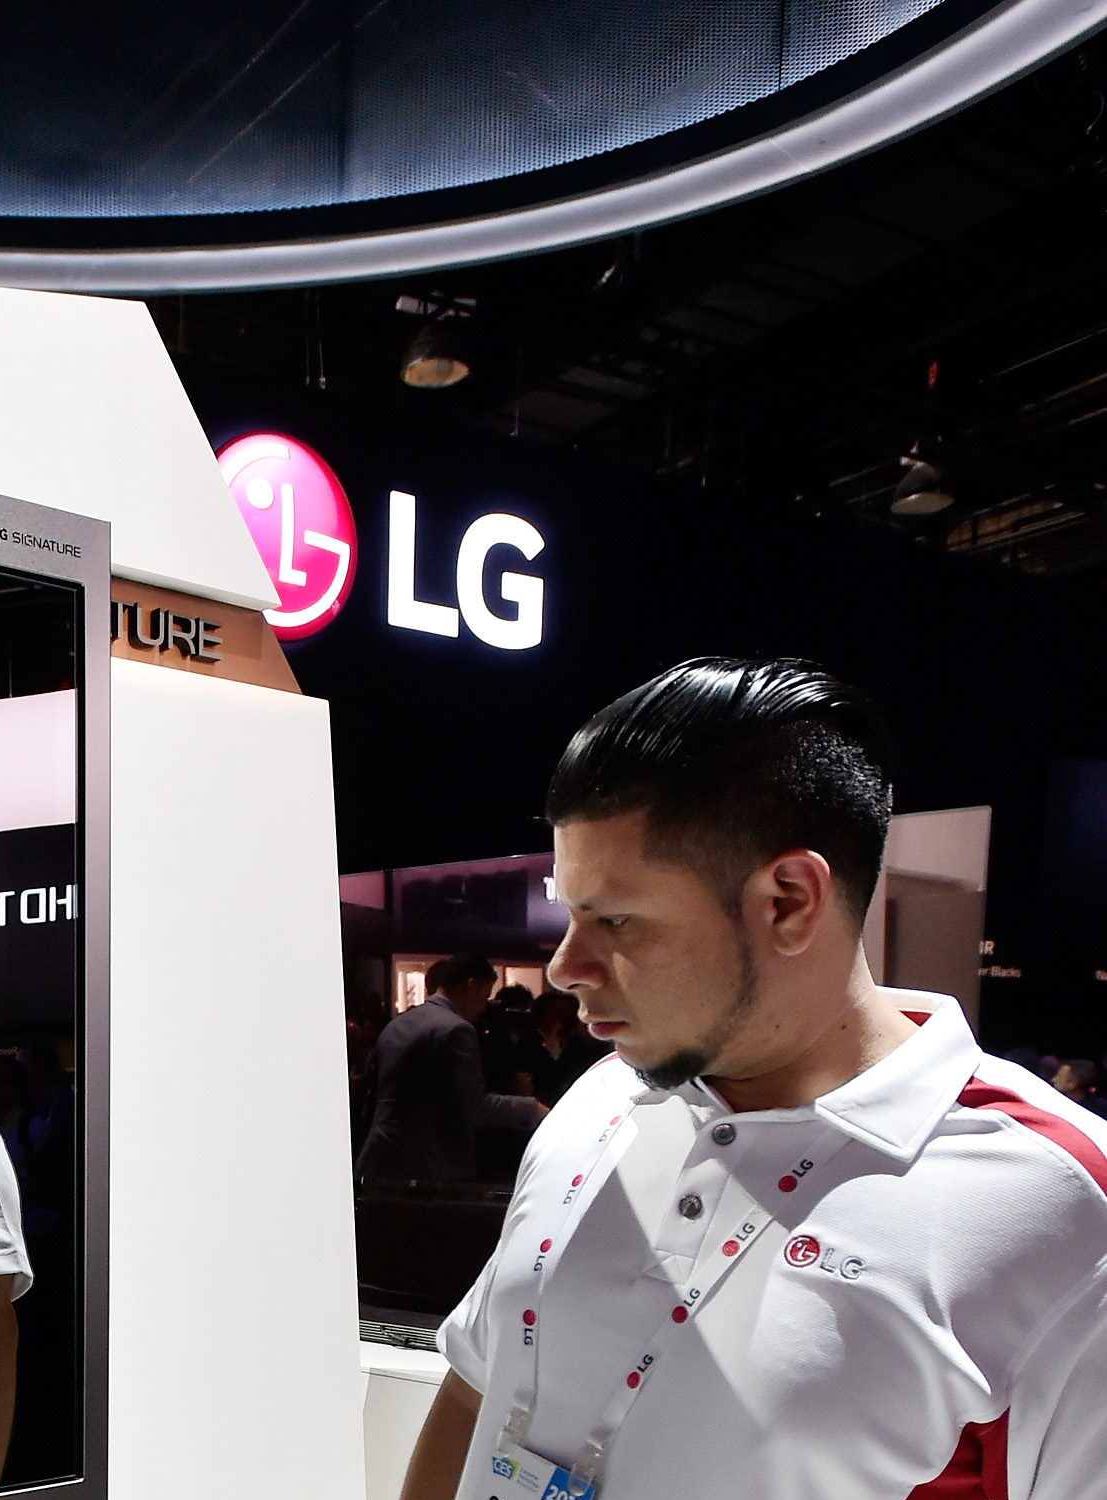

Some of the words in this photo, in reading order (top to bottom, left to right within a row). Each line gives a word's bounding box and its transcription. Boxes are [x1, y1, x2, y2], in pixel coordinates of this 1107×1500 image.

[12, 531, 82, 559] SIGNATURE
[386, 489, 546, 650] LG
[792, 1158, 814, 1179] LG
[563, 1189, 576, 1205] LG
[735, 1222, 756, 1243] LG
[534, 1255, 546, 1272] LG
[819, 1248, 866, 1281] LG
[684, 1287, 701, 1308] LG
[524, 1327, 534, 1346] LG
[637, 1354, 655, 1374] LG
[493, 1459, 513, 1477] CES
